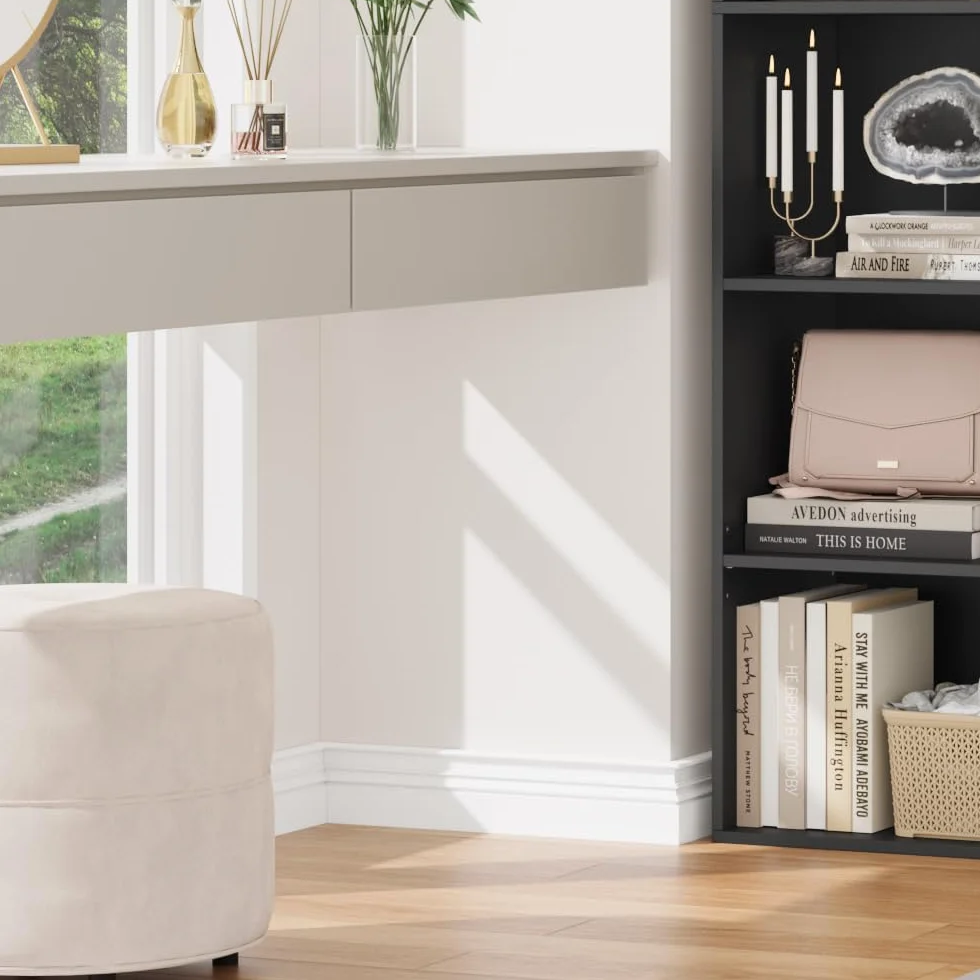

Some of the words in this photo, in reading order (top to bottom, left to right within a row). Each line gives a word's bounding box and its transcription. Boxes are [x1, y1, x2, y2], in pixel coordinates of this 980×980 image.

[875, 222, 906, 231] CLOCKWORK
[907, 222, 929, 230] ORANGE
[947, 237, 972, 252] Harper
[851, 256, 867, 271] AIR
[868, 257, 888, 271] AND
[891, 256, 910, 272] FIRE
[930, 259, 956, 271] RUPERT
[791, 505, 846, 522] AVEDON
[850, 508, 917, 527] advertising
[759, 535, 783, 544] NATALIE
[783, 536, 807, 544] WALTON
[815, 533, 847, 549] THIS
[850, 535, 862, 549] IS
[866, 536, 907, 551] HOME
[741, 624, 754, 653] The
[855, 632, 868, 657] STAY
[834, 642, 848, 702] Arianna
[855, 661, 868, 689] WITH
[855, 693, 868, 709] ME
[830, 708, 848, 791] Huffington
[855, 717, 869, 766] AYOBAMI
[744, 750, 752, 786] MATTHEW
[744, 789, 752, 813] STONE
[855, 769, 869, 818] ADEBAYO
